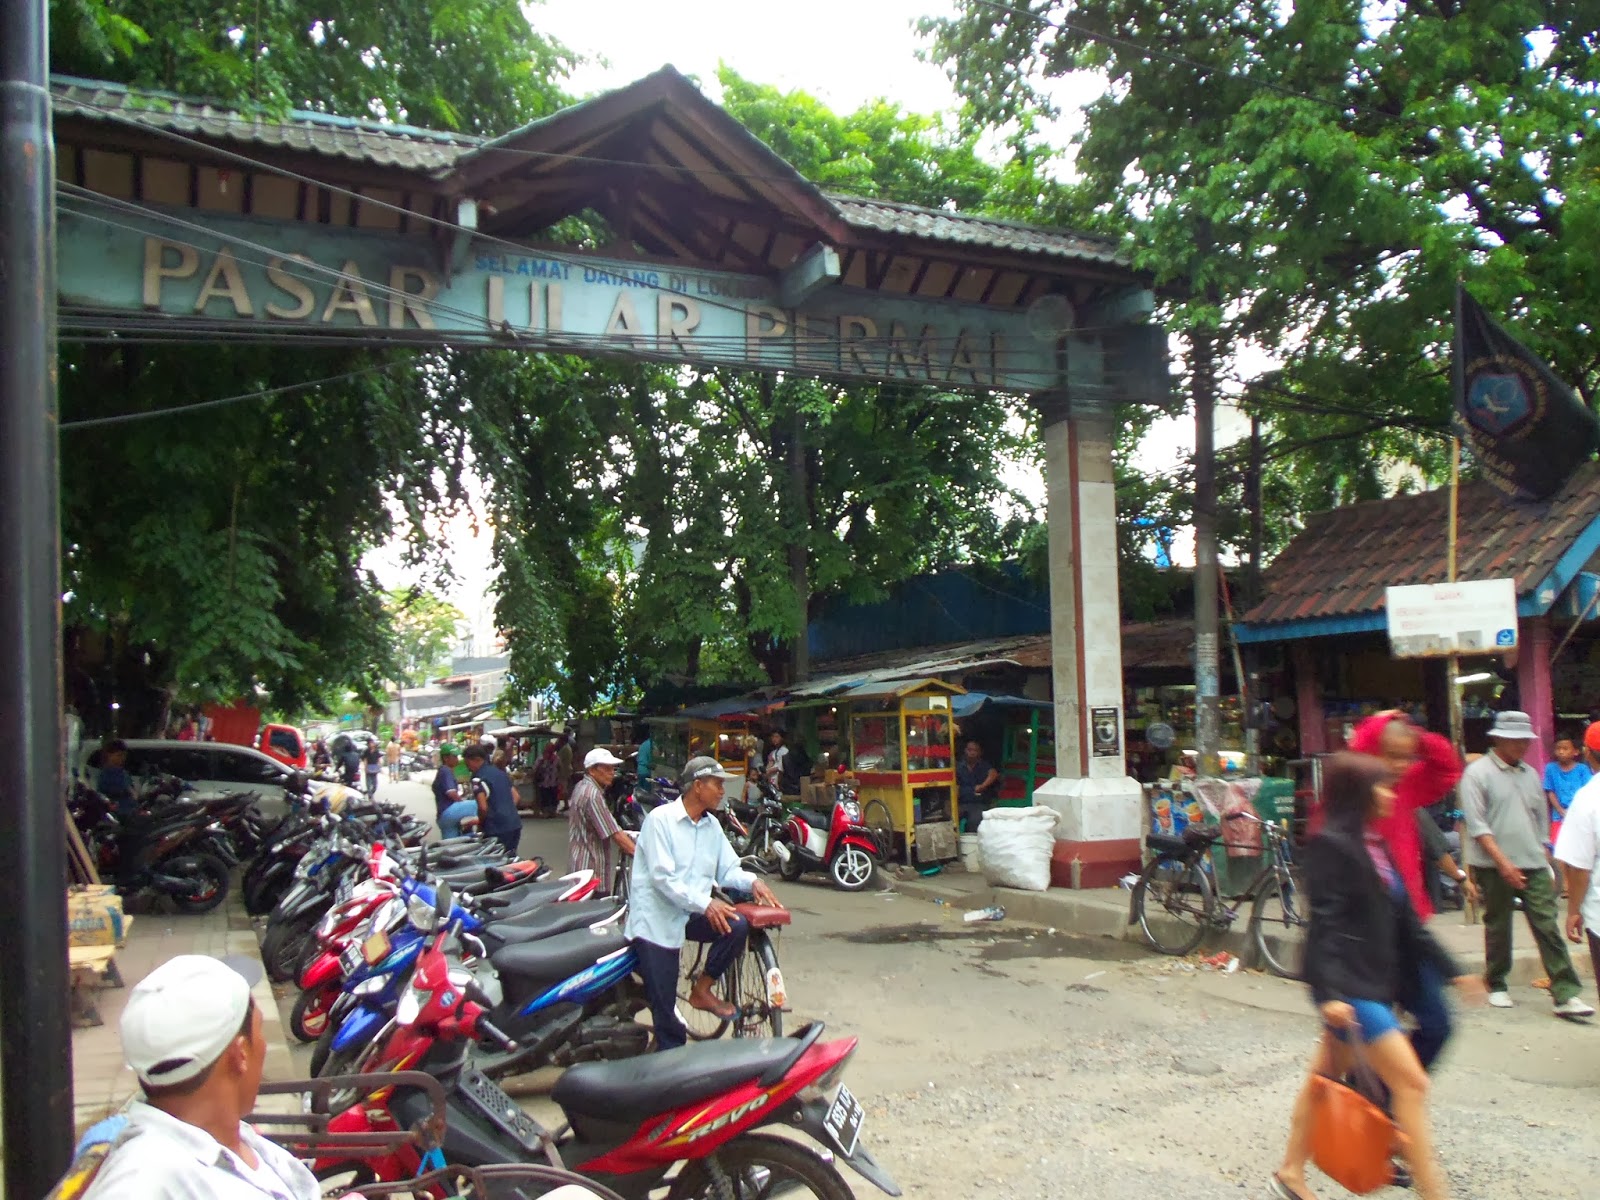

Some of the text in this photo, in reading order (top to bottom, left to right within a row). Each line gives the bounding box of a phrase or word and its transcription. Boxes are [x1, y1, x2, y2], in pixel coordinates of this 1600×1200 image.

[142, 236, 1009, 384] PASAR ULAR PERMAI
[475, 255, 571, 281] SELAMAT
[583, 266, 660, 289] DATANG
[668, 273, 688, 293] DI
